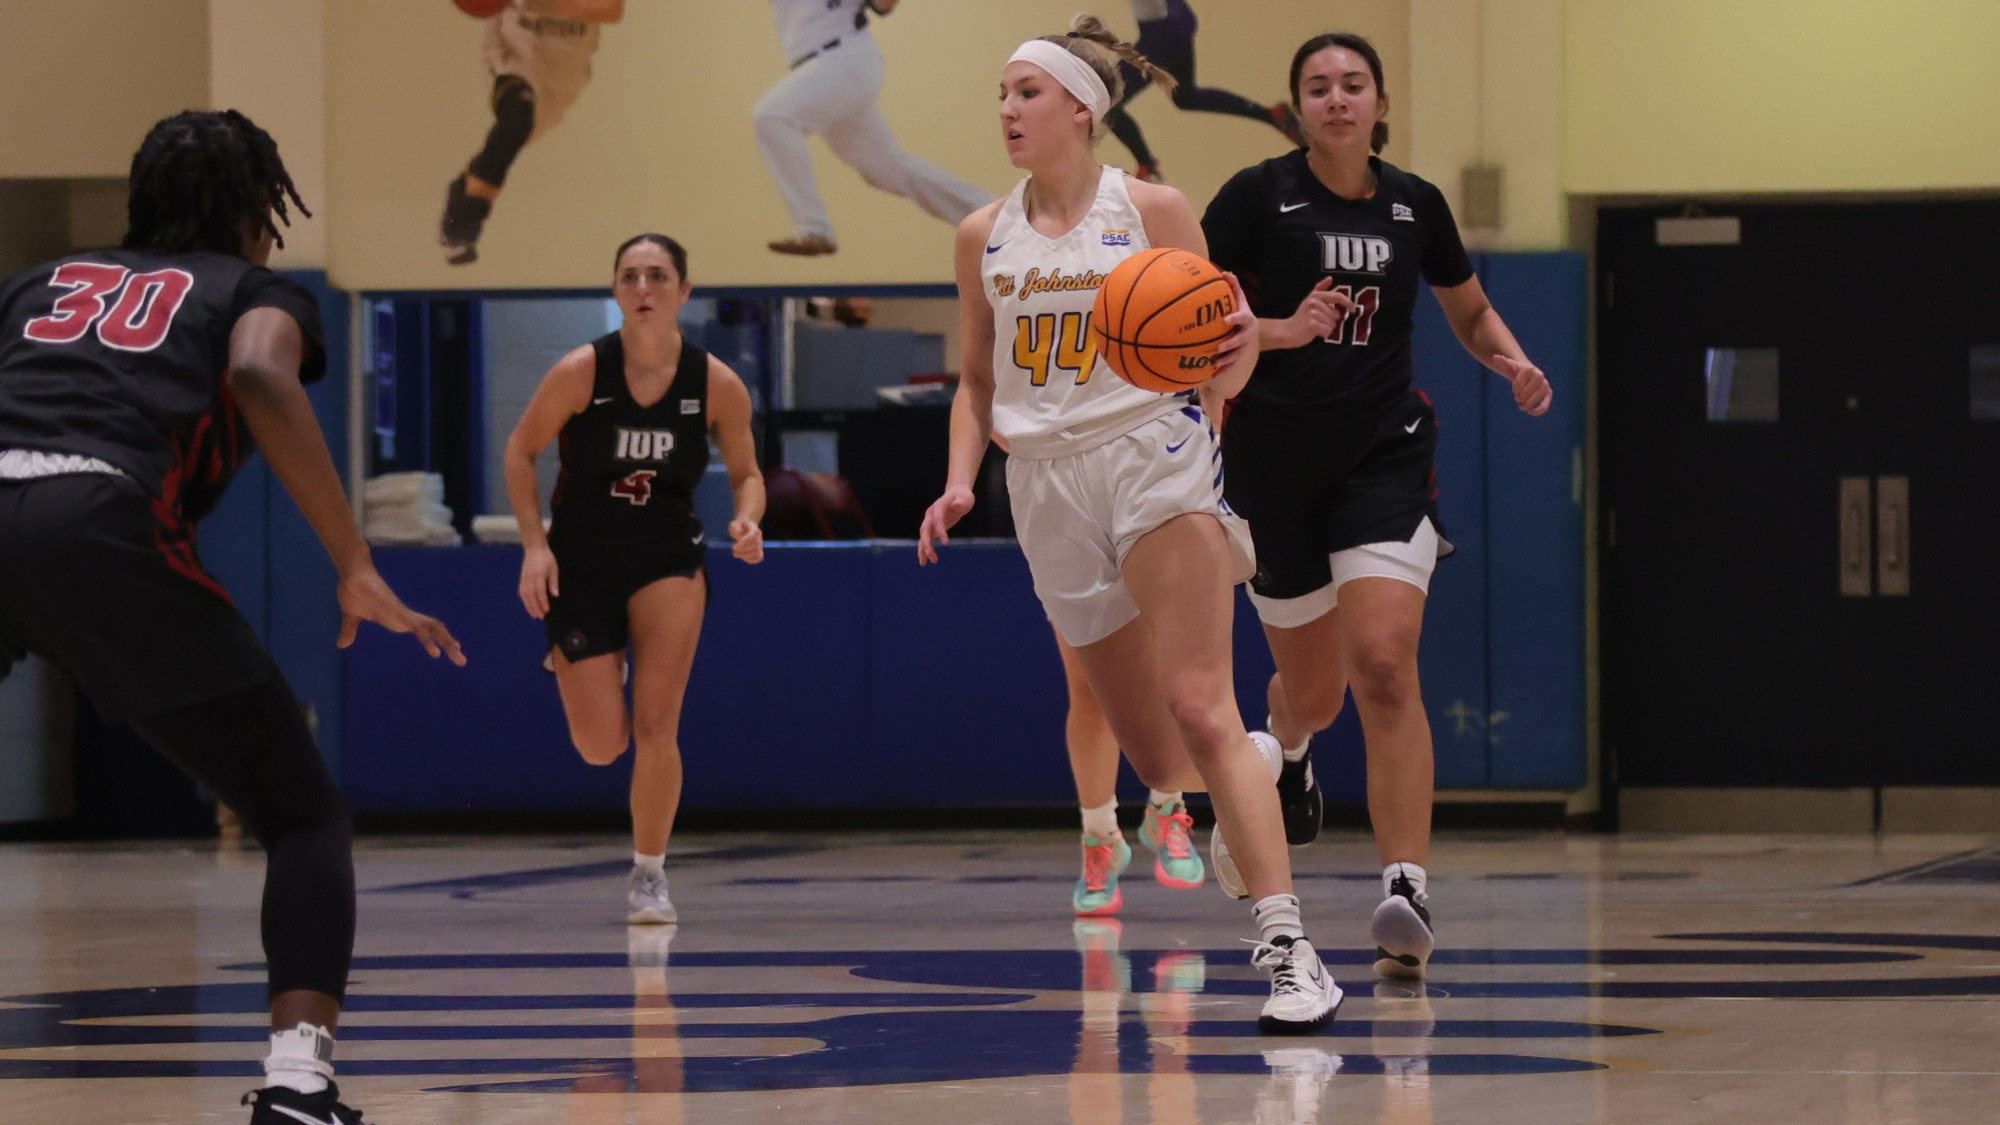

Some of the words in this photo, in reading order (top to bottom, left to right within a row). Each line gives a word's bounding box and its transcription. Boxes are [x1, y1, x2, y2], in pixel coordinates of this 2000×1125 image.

[1101, 233, 1131, 242] PSAC
[1320, 234, 1392, 273] IUP
[1019, 267, 1109, 301] Johnsto
[23, 262, 194, 352] 30
[1196, 294, 1232, 327] EVO
[1324, 284, 1381, 346] 11
[1012, 311, 1098, 387] 44
[615, 427, 675, 461] IUP
[610, 469, 657, 506] 4
